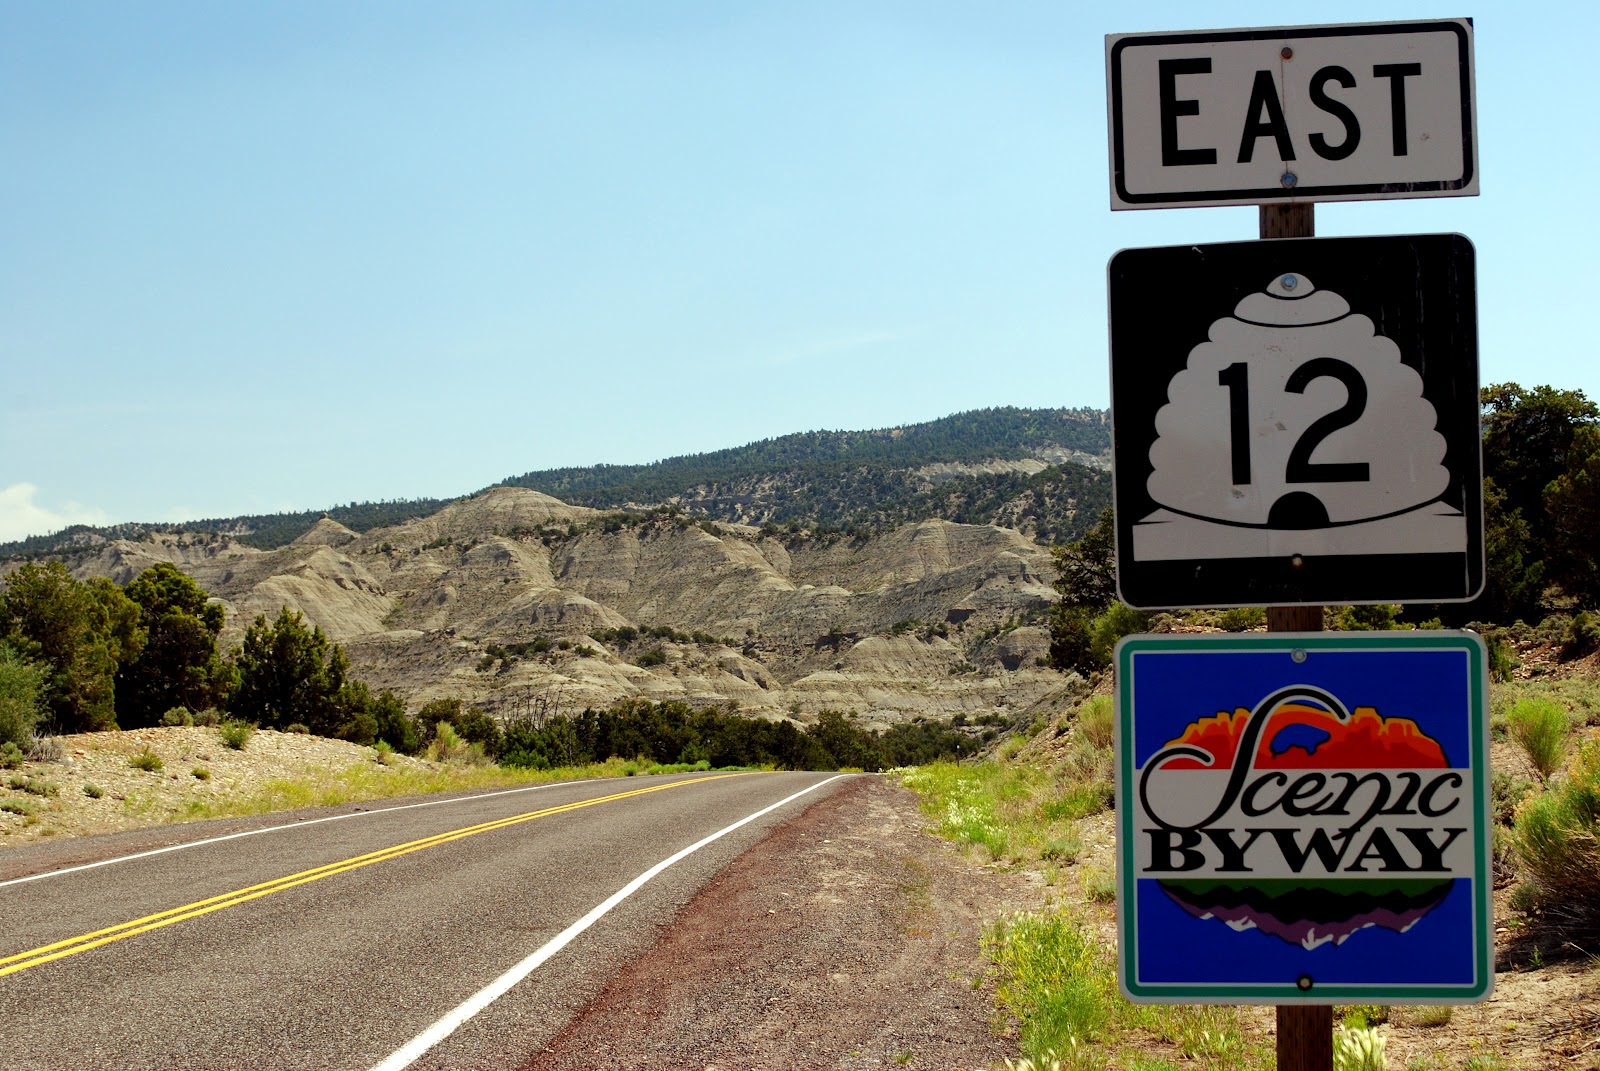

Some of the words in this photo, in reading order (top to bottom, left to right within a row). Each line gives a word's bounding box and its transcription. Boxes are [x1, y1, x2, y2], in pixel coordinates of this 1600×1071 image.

[1158, 57, 1422, 167] EAST
[1218, 357, 1370, 485] 12
[1139, 687, 1463, 840] Scenic
[1142, 826, 1467, 873] BYWAY
